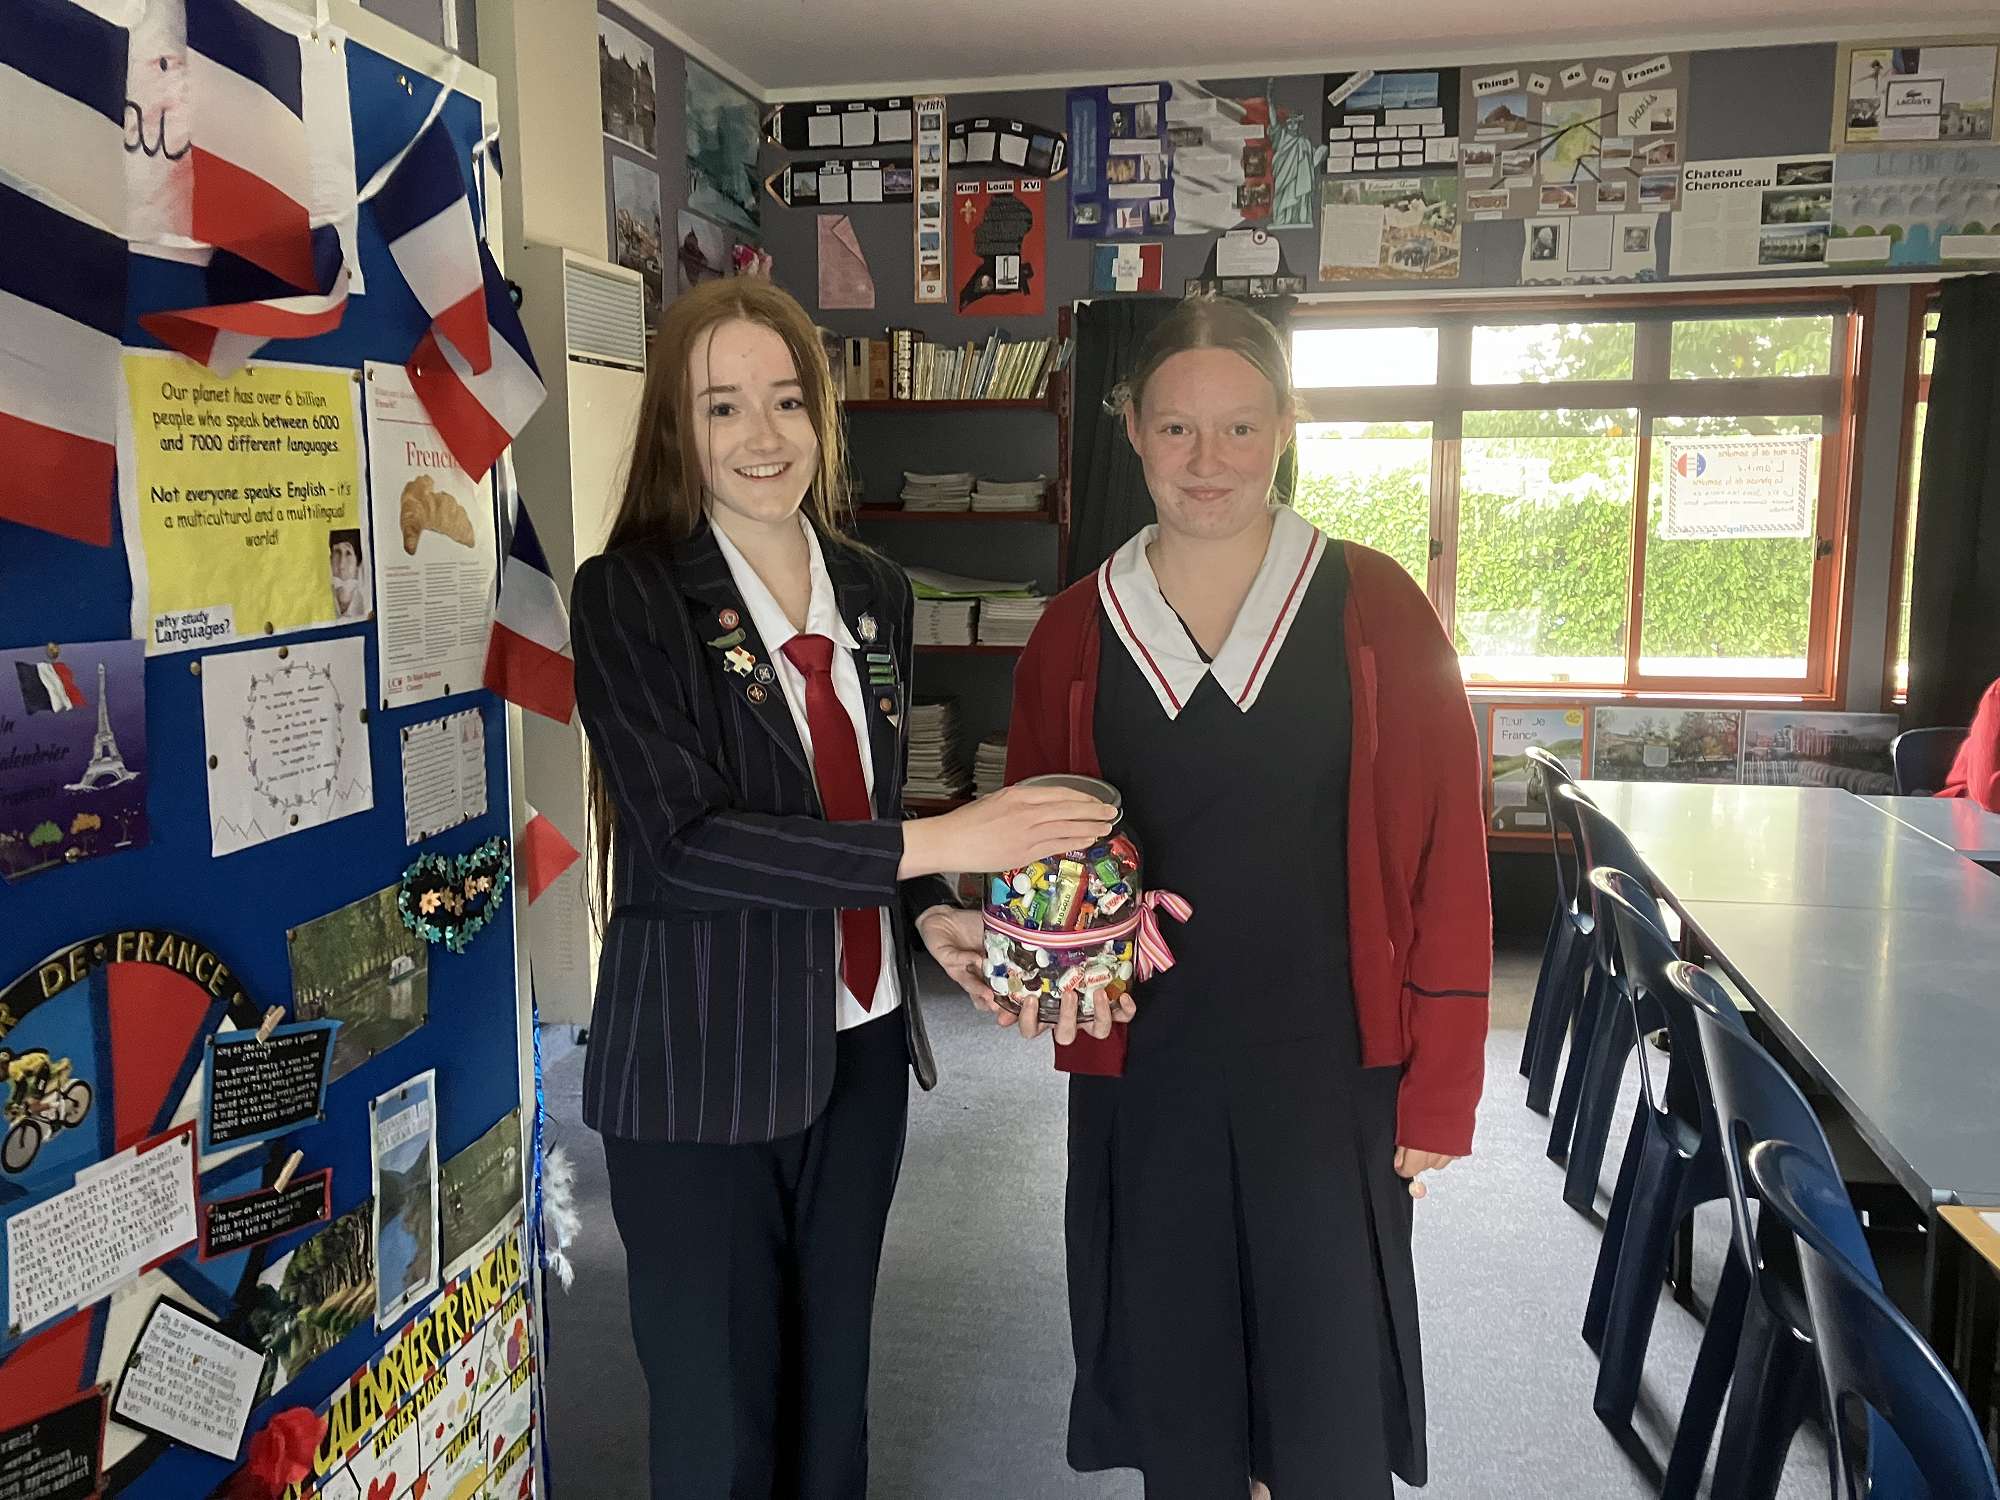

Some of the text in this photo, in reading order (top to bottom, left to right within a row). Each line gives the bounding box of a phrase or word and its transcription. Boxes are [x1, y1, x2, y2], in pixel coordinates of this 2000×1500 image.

[1477, 62, 1666, 90] Things to do in France
[1685, 168, 1743, 180] Chateau
[1685, 179, 1771, 191] Chenonceau
[957, 181, 1040, 193] King Louis XVI
[161, 382, 327, 407] Our planet has over 6 billion
[153, 409, 339, 434] people who speak between 6000
[160, 434, 183, 450] and
[191, 435, 222, 450] 7000
[228, 436, 280, 452] different
[151, 485, 180, 503] Not
[186, 484, 238, 505] everyone
[244, 484, 280, 501] speaks
[288, 482, 326, 503] English
[164, 504, 344, 528] a multicultural and a multilingual
[246, 530, 279, 547] world!
[155, 619, 231, 643] Languages?
[156, 612, 209, 630] why study
[39, 946, 88, 998] DE
[116, 932, 230, 997] FRANCE
[314, 1316, 438, 1477] CALENDRIER
[416, 1367, 448, 1413] MARS
